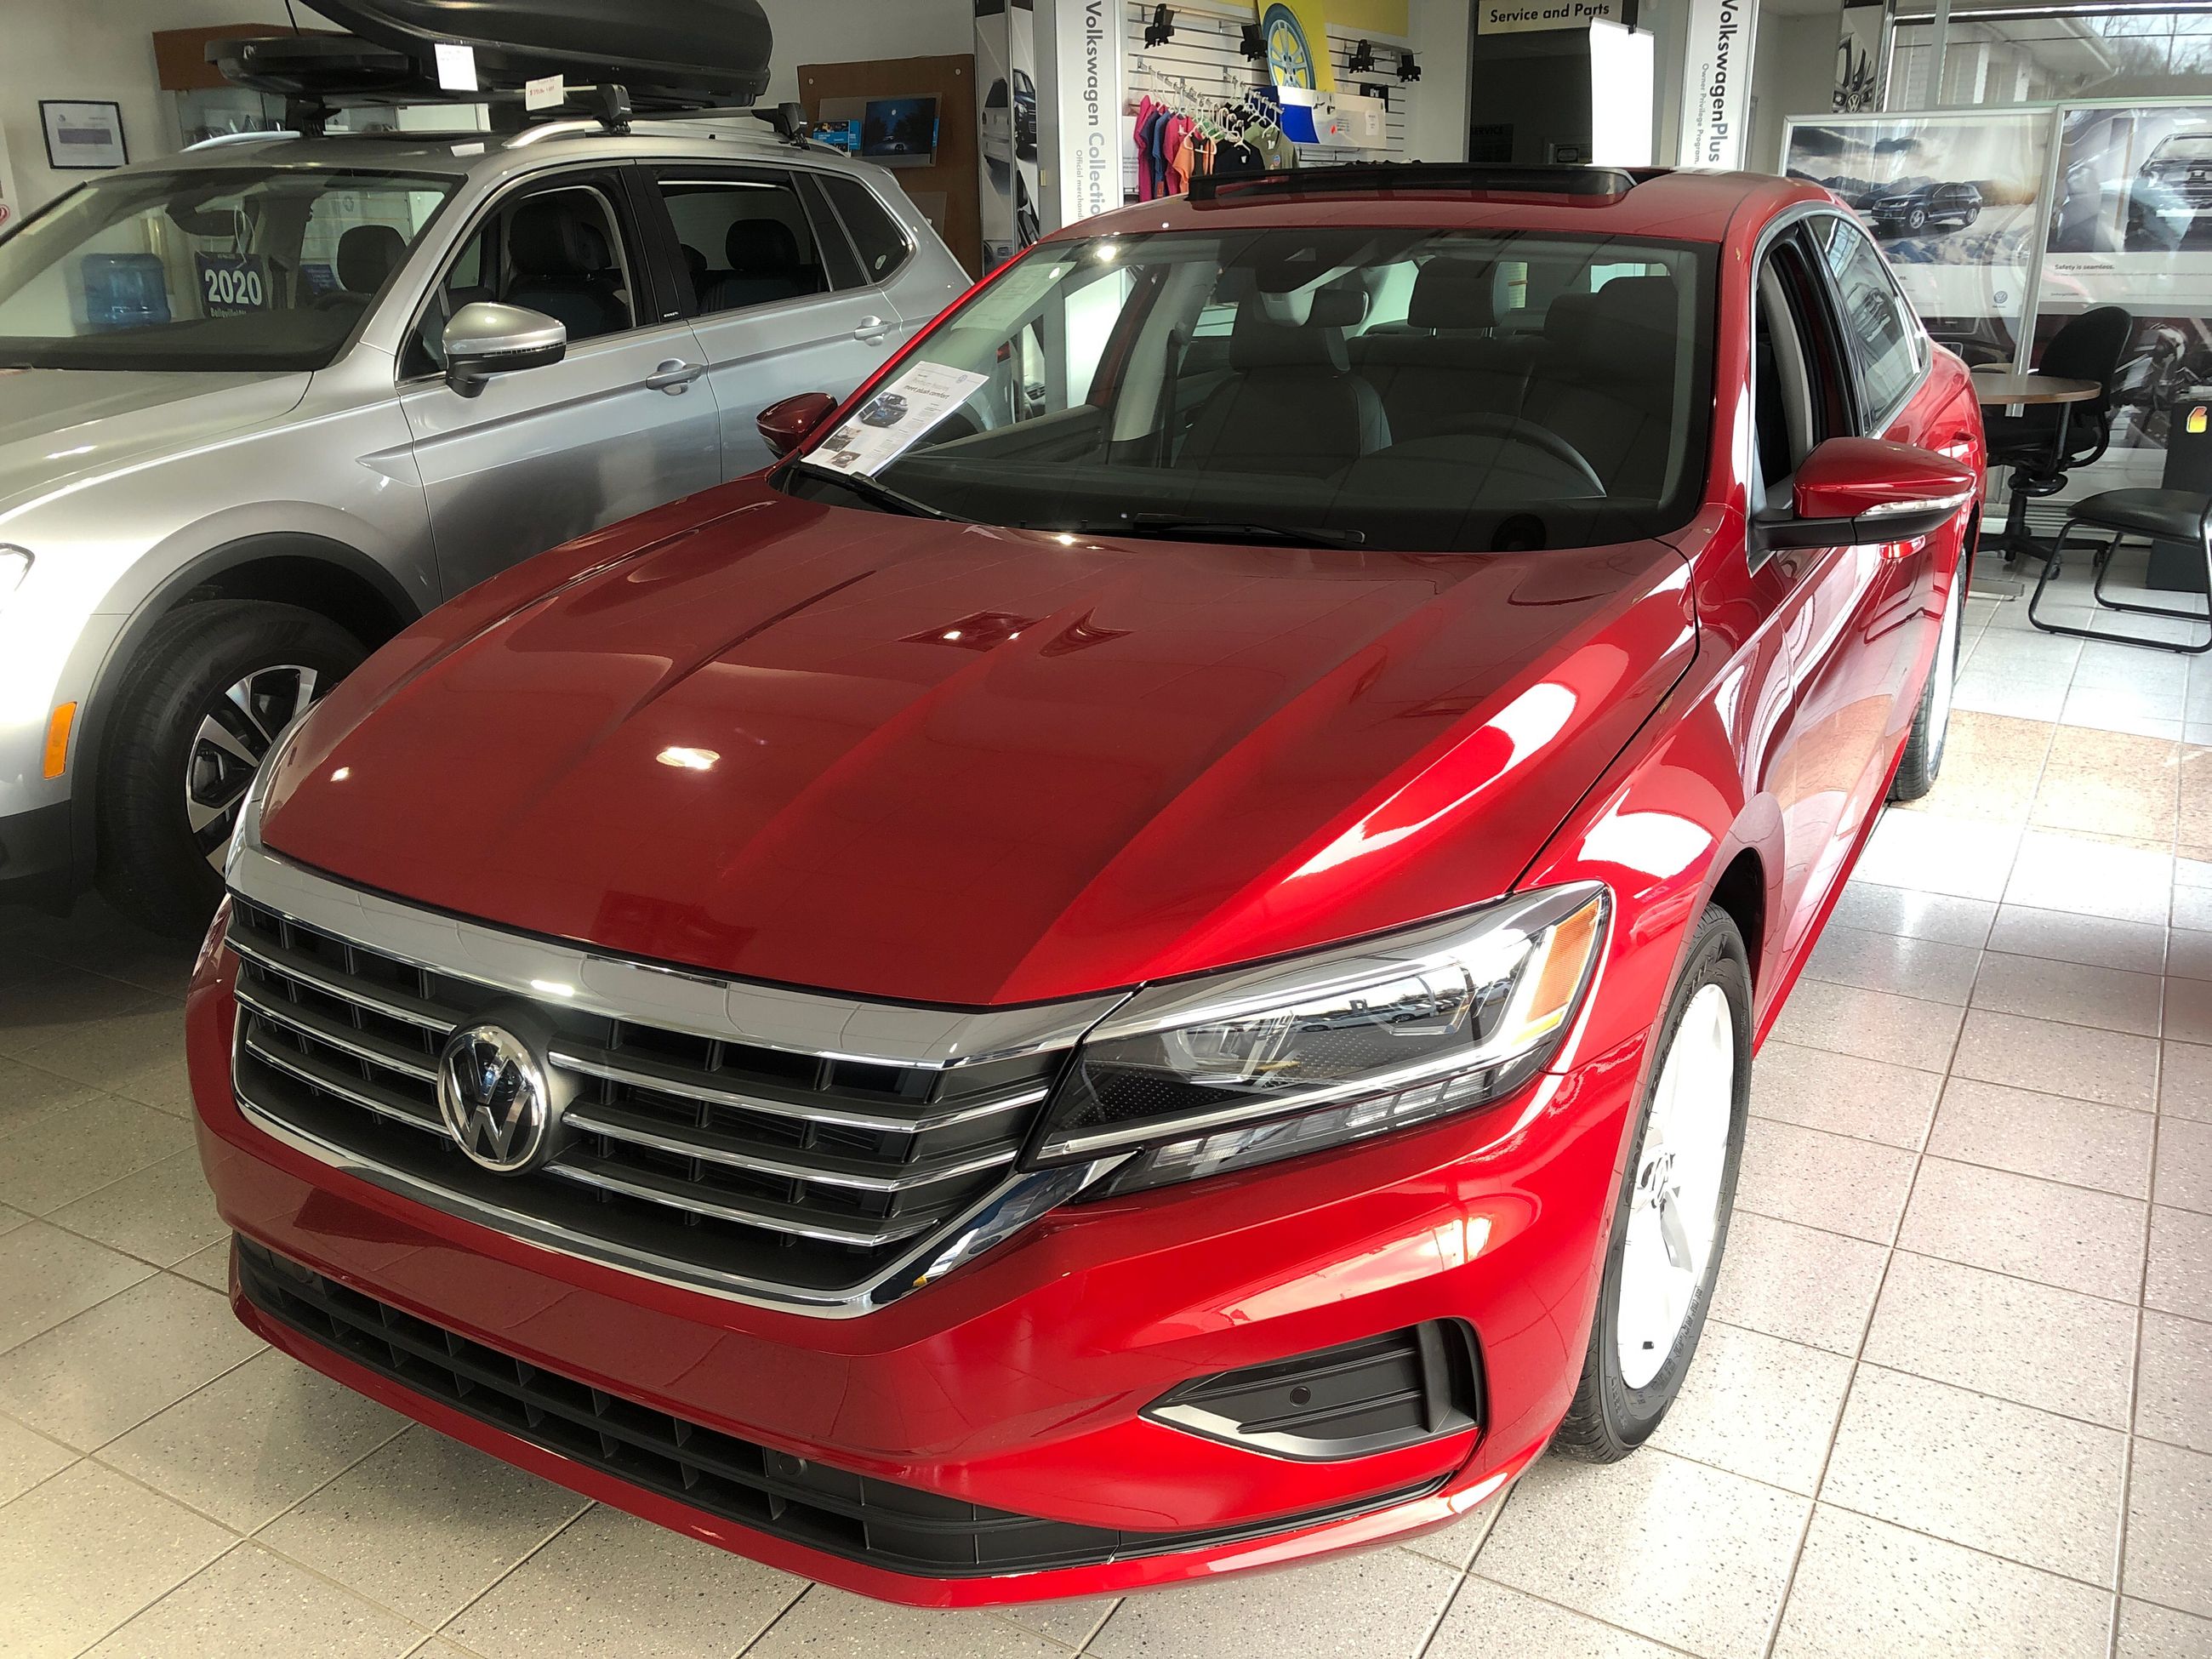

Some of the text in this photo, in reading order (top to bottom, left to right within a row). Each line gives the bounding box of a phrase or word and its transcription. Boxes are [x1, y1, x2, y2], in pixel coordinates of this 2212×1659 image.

[1490, 3, 1610, 23] Service and Parts
[1083, 1, 1103, 126] Volkswagen
[1708, 0, 1739, 162] VolkswagenPlus
[1694, 63, 1709, 164] Owner Privilege Program.
[1075, 150, 1084, 178] Official
[204, 269, 262, 306] 2020
